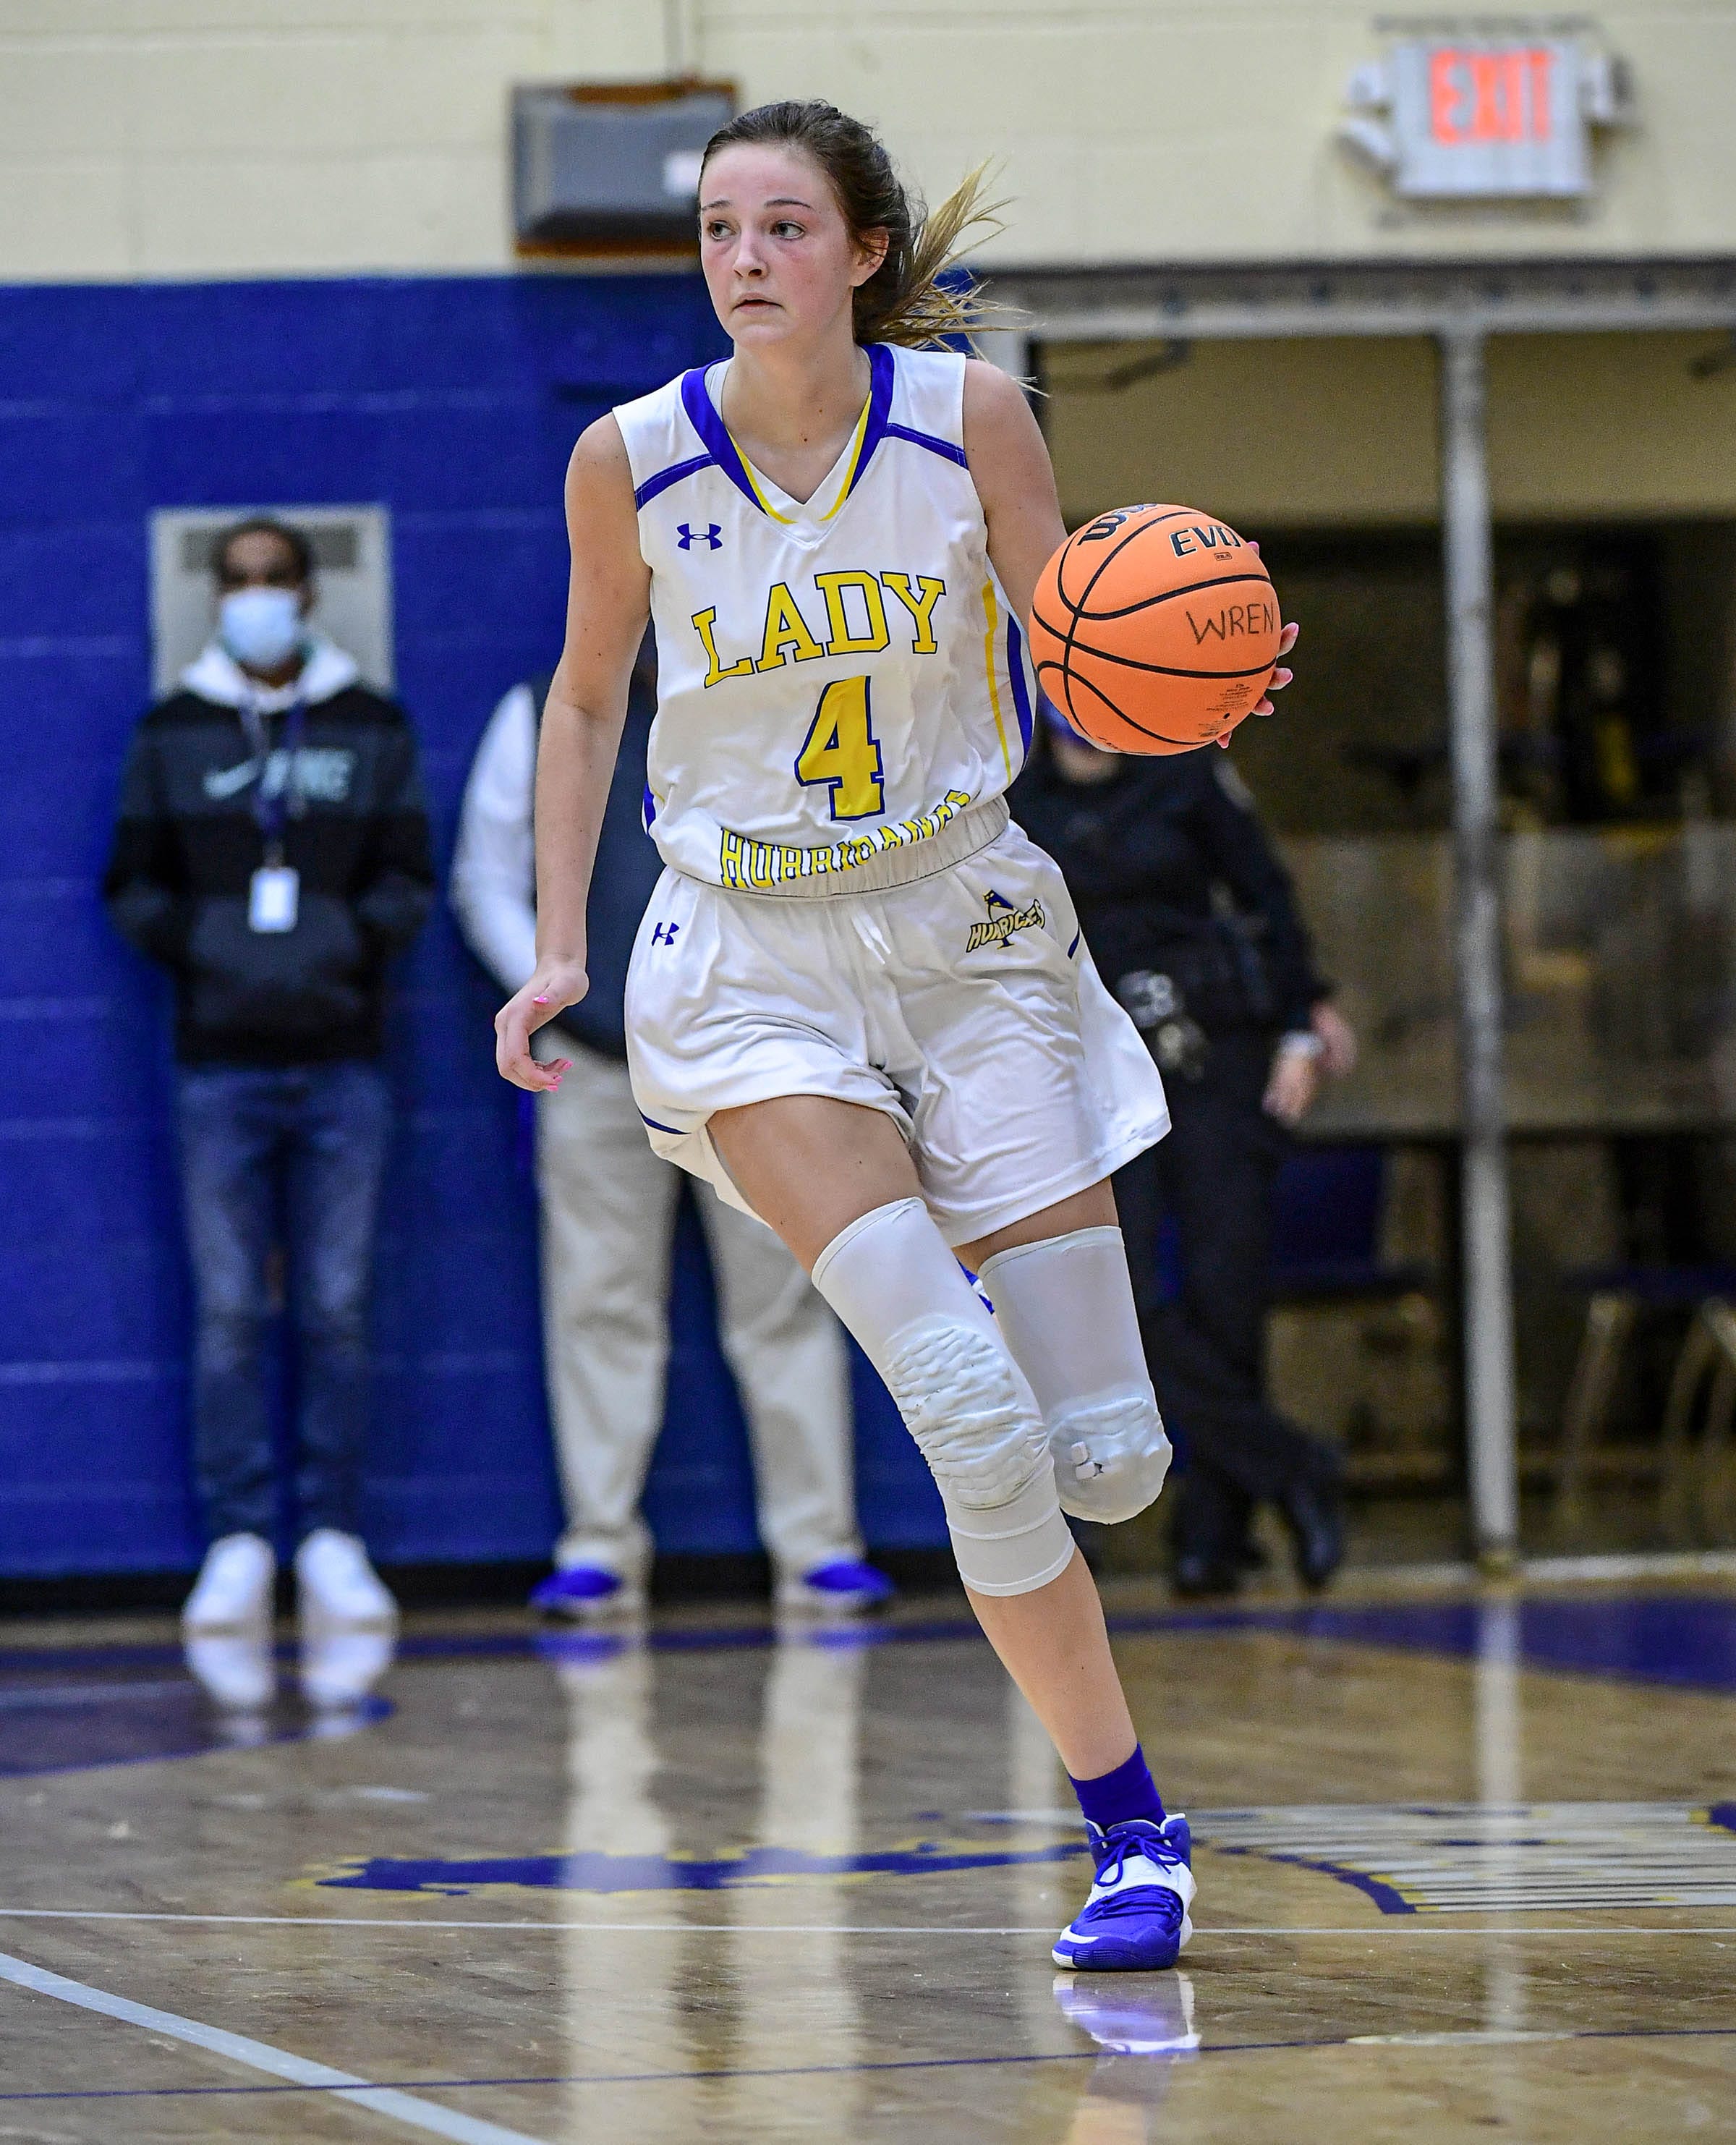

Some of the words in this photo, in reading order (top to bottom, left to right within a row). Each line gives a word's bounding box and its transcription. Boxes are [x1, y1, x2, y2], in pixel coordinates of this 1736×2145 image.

[1429, 48, 1550, 145] EXIT
[1169, 524, 1242, 558] EVO
[691, 569, 947, 688] LADY
[1185, 603, 1274, 645] WREN
[794, 675, 885, 821] 4
